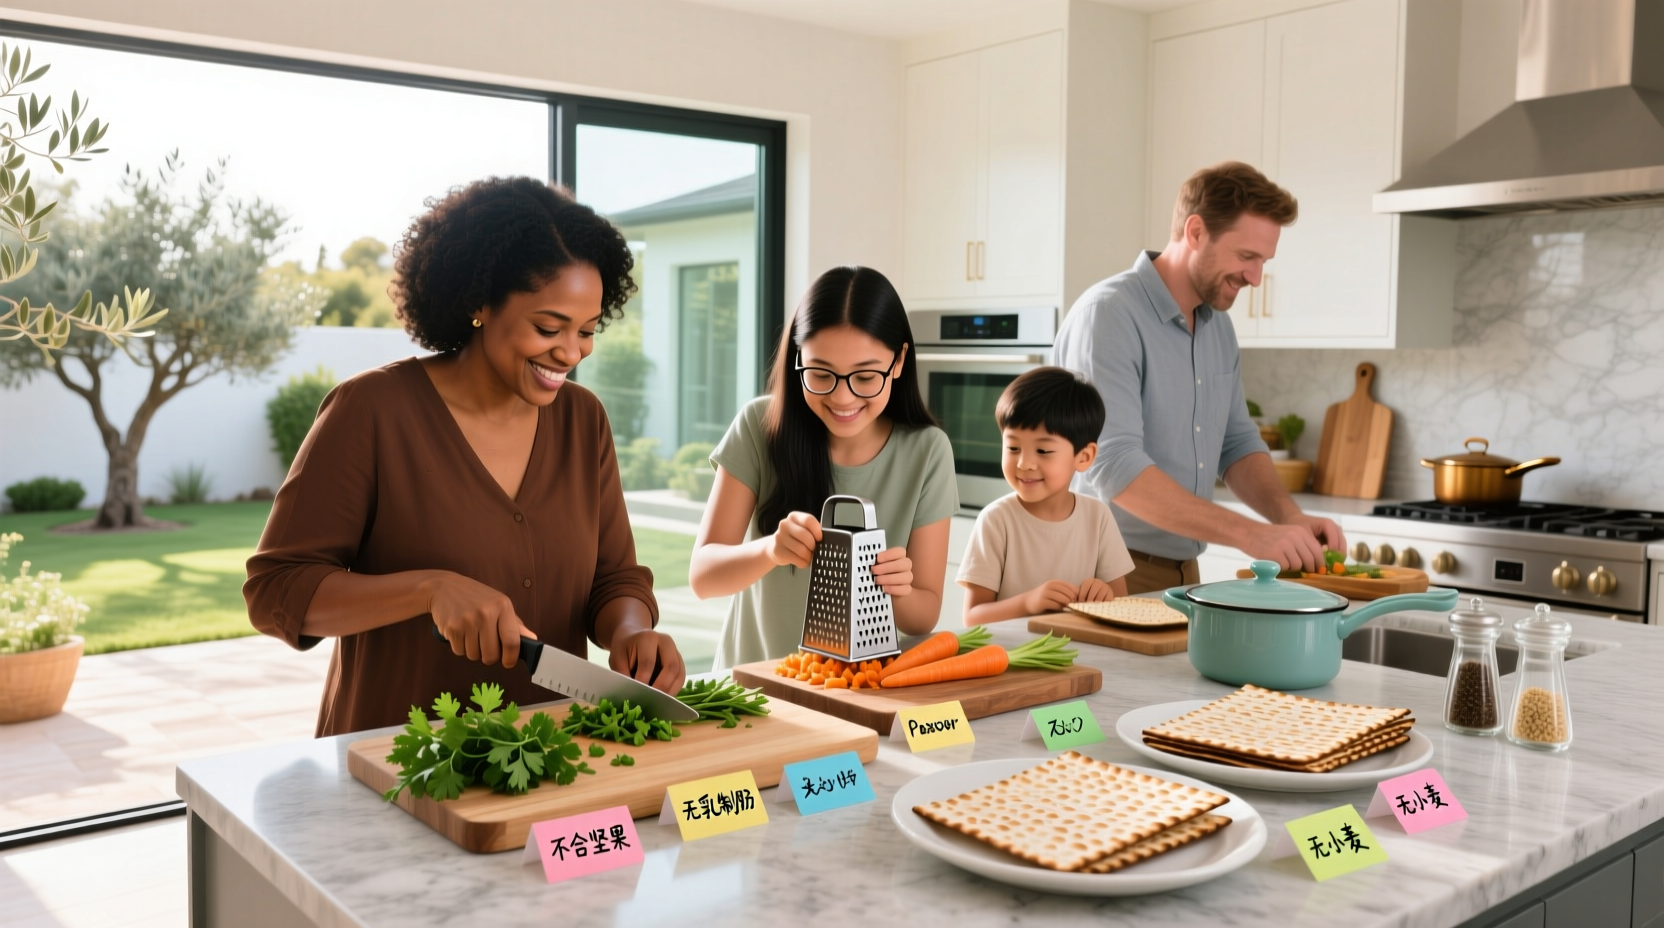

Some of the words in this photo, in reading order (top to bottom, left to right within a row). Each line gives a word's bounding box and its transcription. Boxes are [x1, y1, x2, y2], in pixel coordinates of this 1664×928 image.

[1396, 783, 1449, 815] 无小麦
[1307, 822, 1370, 859] 无小麦
